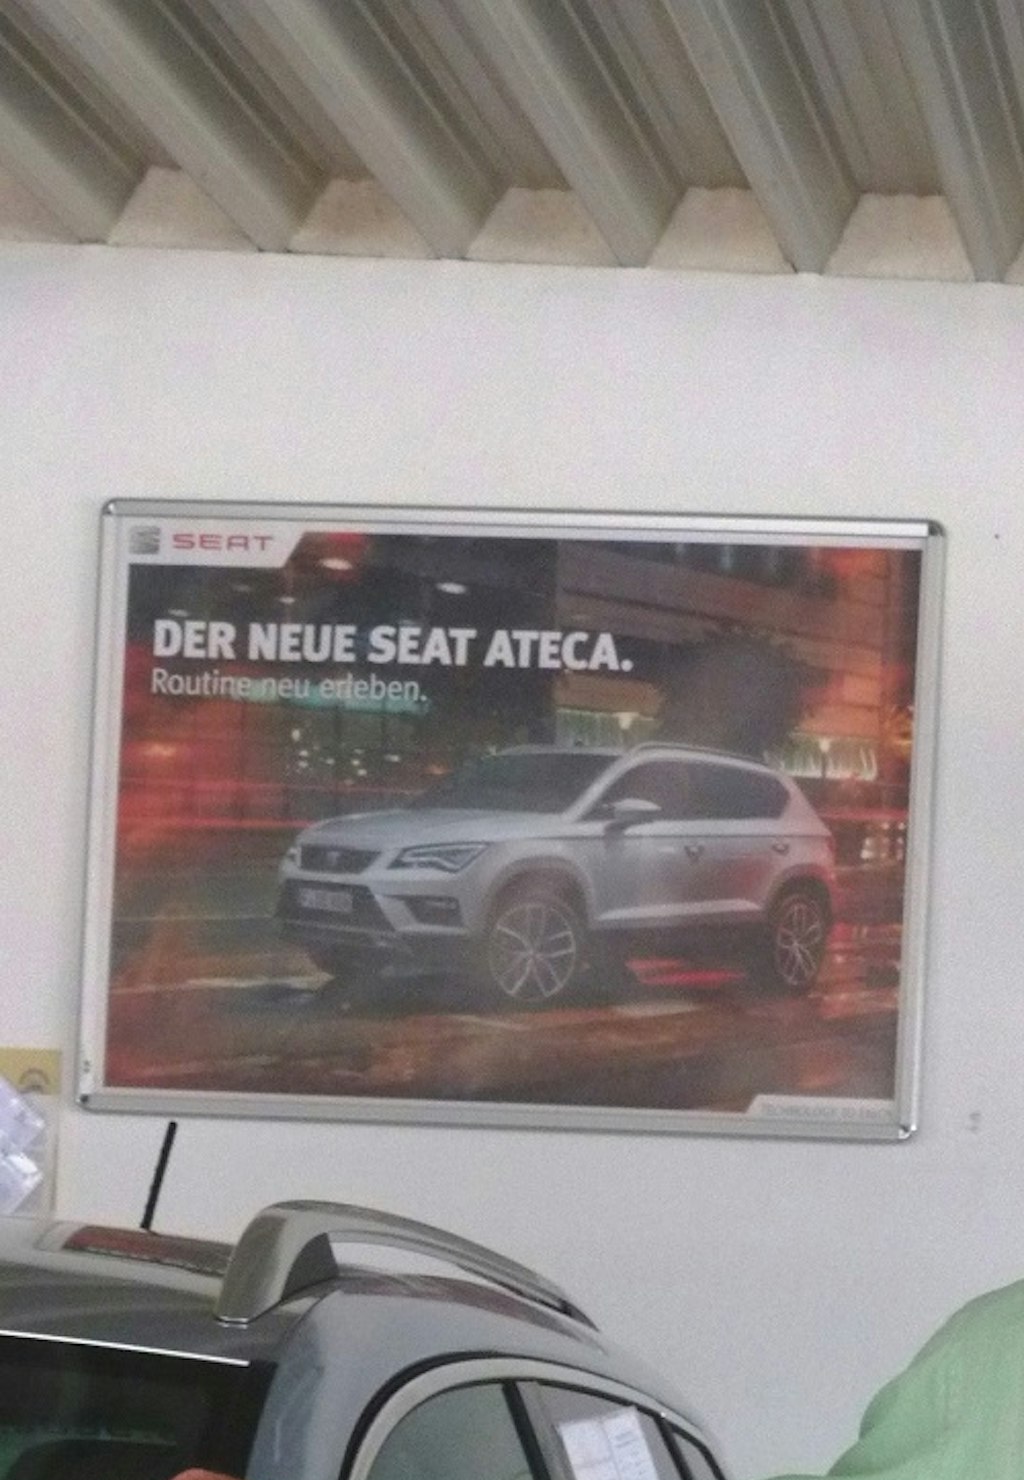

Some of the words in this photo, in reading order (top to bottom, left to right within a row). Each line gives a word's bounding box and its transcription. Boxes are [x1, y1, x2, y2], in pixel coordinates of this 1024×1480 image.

[172, 532, 274, 551] SEAT
[153, 618, 237, 660] DER
[248, 621, 357, 663] NEUE
[367, 624, 478, 667] SEAT
[483, 629, 634, 672] ATECA.
[151, 667, 250, 697] Routine
[261, 678, 310, 698] neu
[319, 672, 428, 702] erleben.
